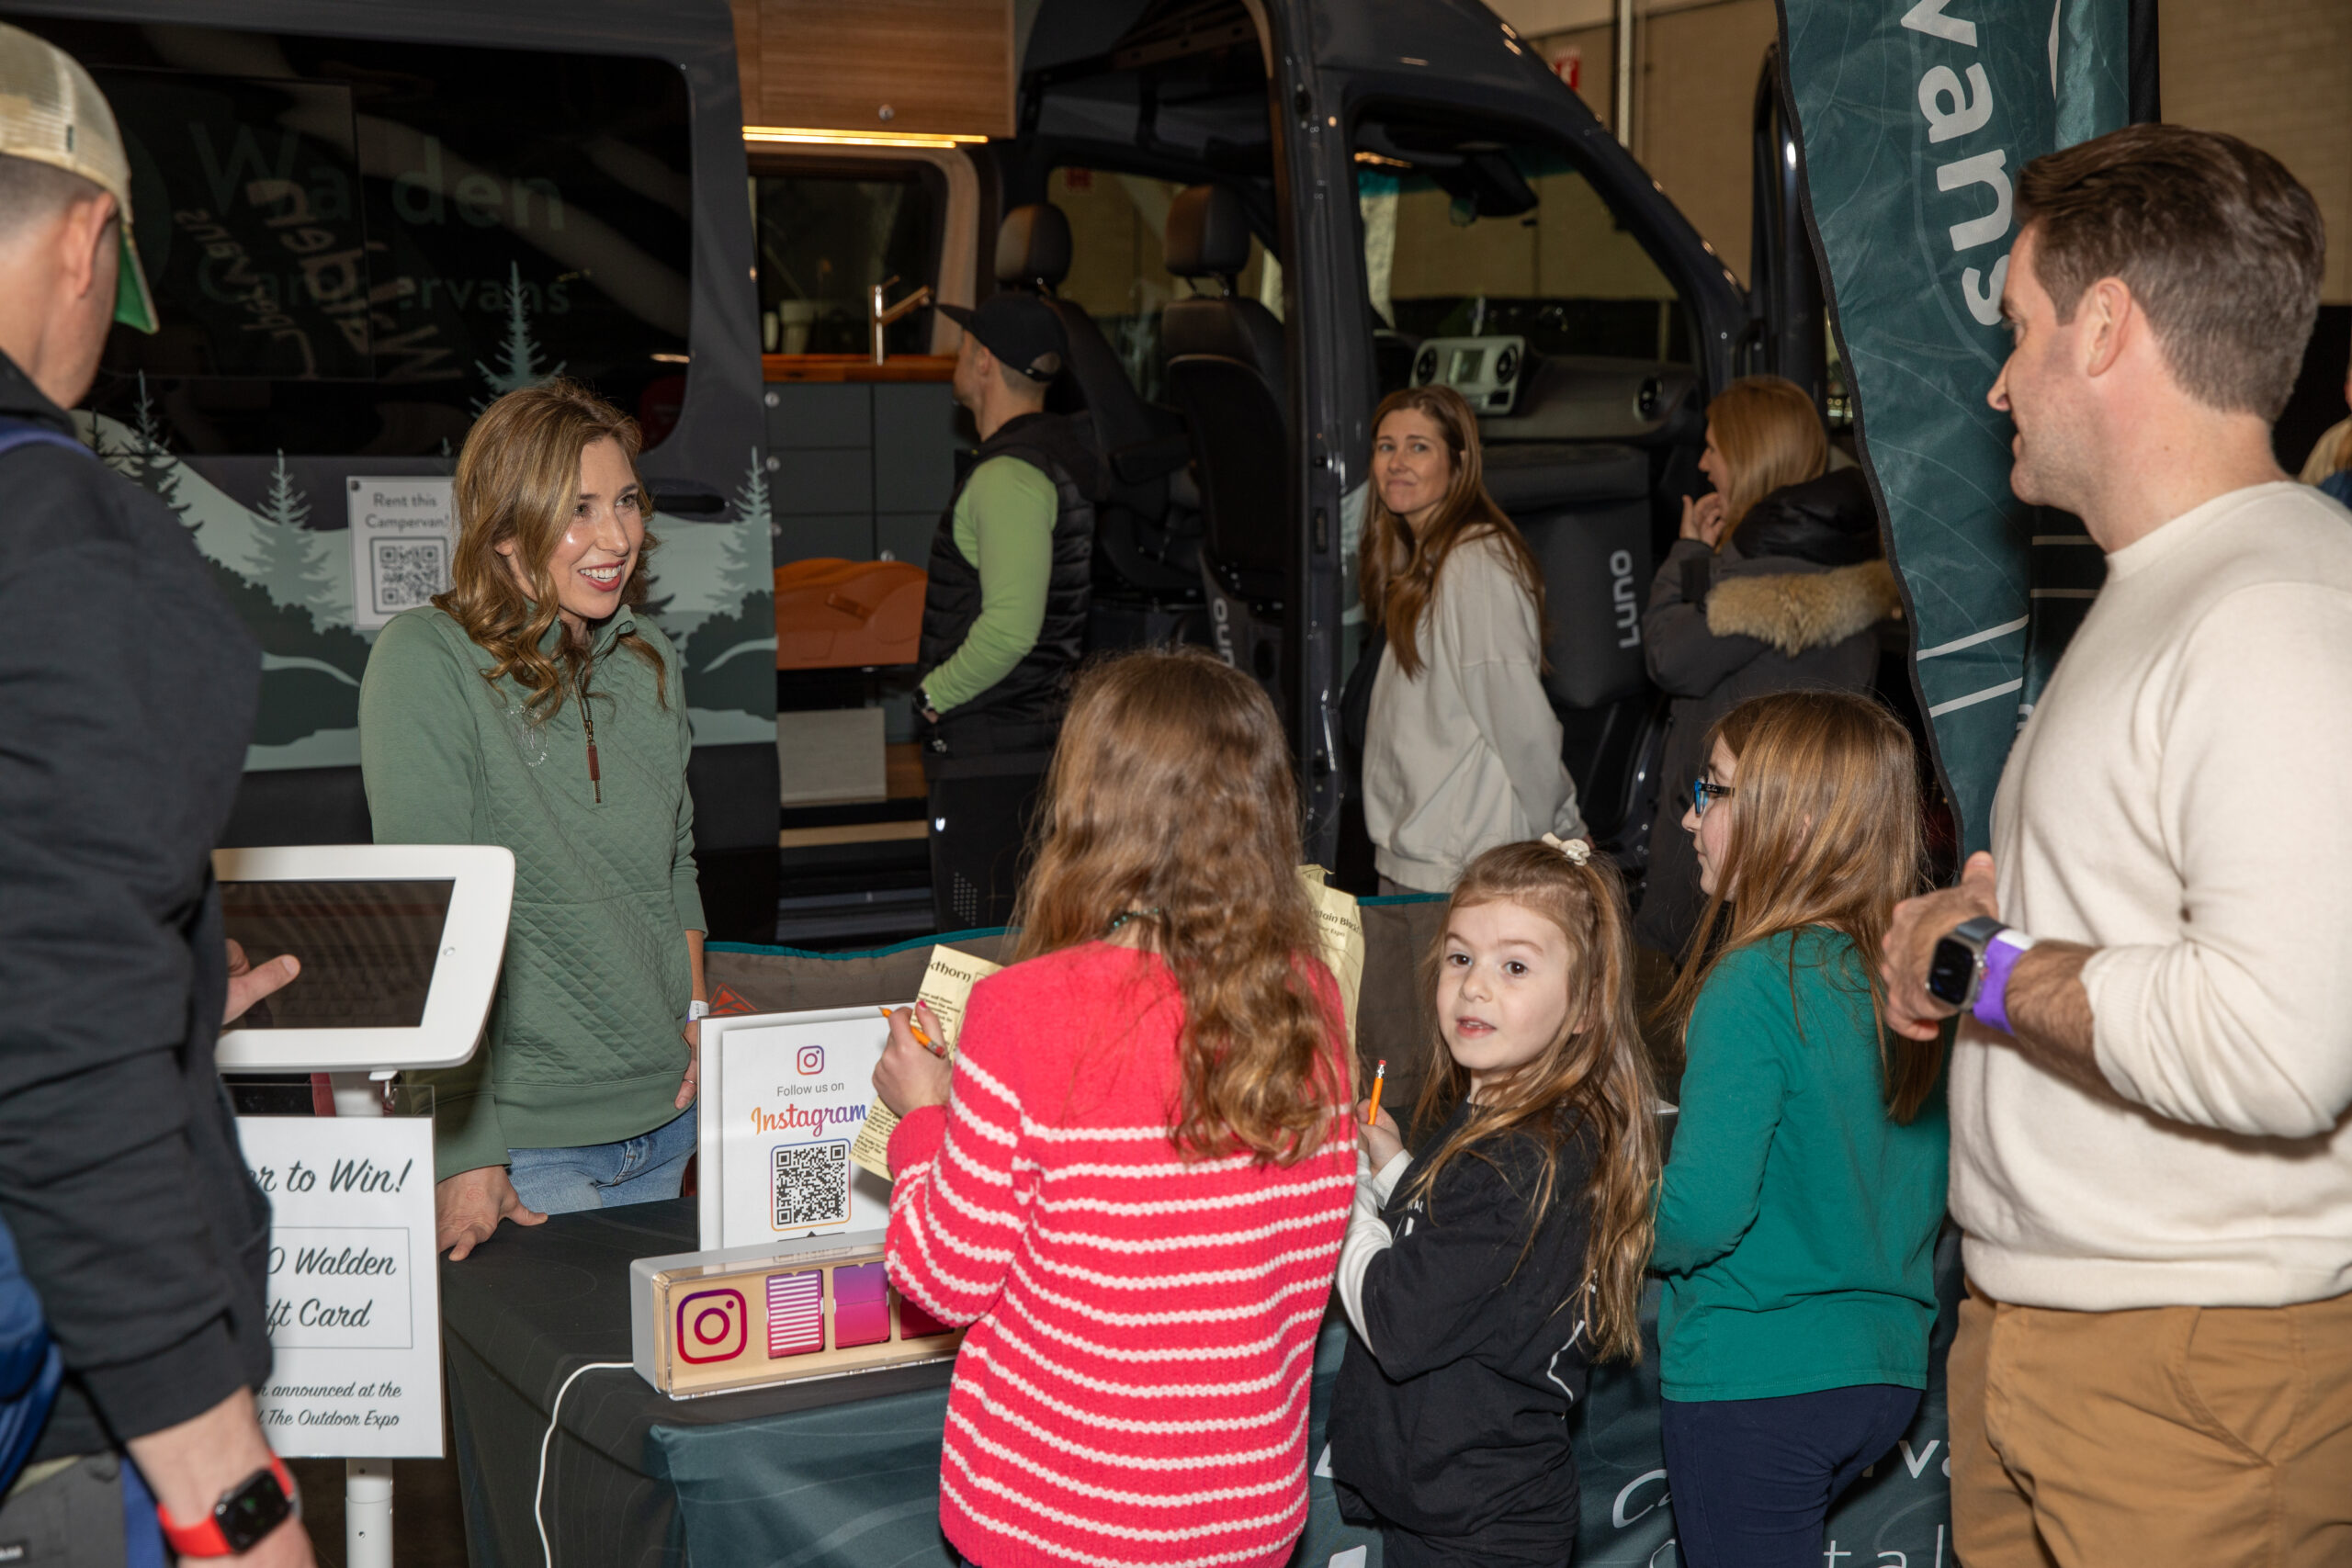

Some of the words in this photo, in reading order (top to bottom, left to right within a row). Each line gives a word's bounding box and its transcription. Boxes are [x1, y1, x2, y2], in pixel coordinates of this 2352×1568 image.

[188, 121, 566, 231] Waden
[373, 491, 407, 507] Rent
[409, 491, 437, 507] this
[365, 513, 450, 534] Campervan!
[776, 1084, 812, 1097] Follow
[815, 1084, 829, 1093] us
[831, 1082, 844, 1091] on
[751, 1103, 868, 1137] Instagram
[286, 1160, 316, 1192] to
[330, 1158, 413, 1193] Win!
[294, 1247, 397, 1276] Walden
[299, 1298, 373, 1327] Card
[272, 1381, 356, 1397] announced
[358, 1382, 375, 1397] at
[379, 1381, 401, 1397] the
[268, 1409, 293, 1426] The
[299, 1409, 360, 1426] Outdoor
[364, 1410, 400, 1430] Expo
